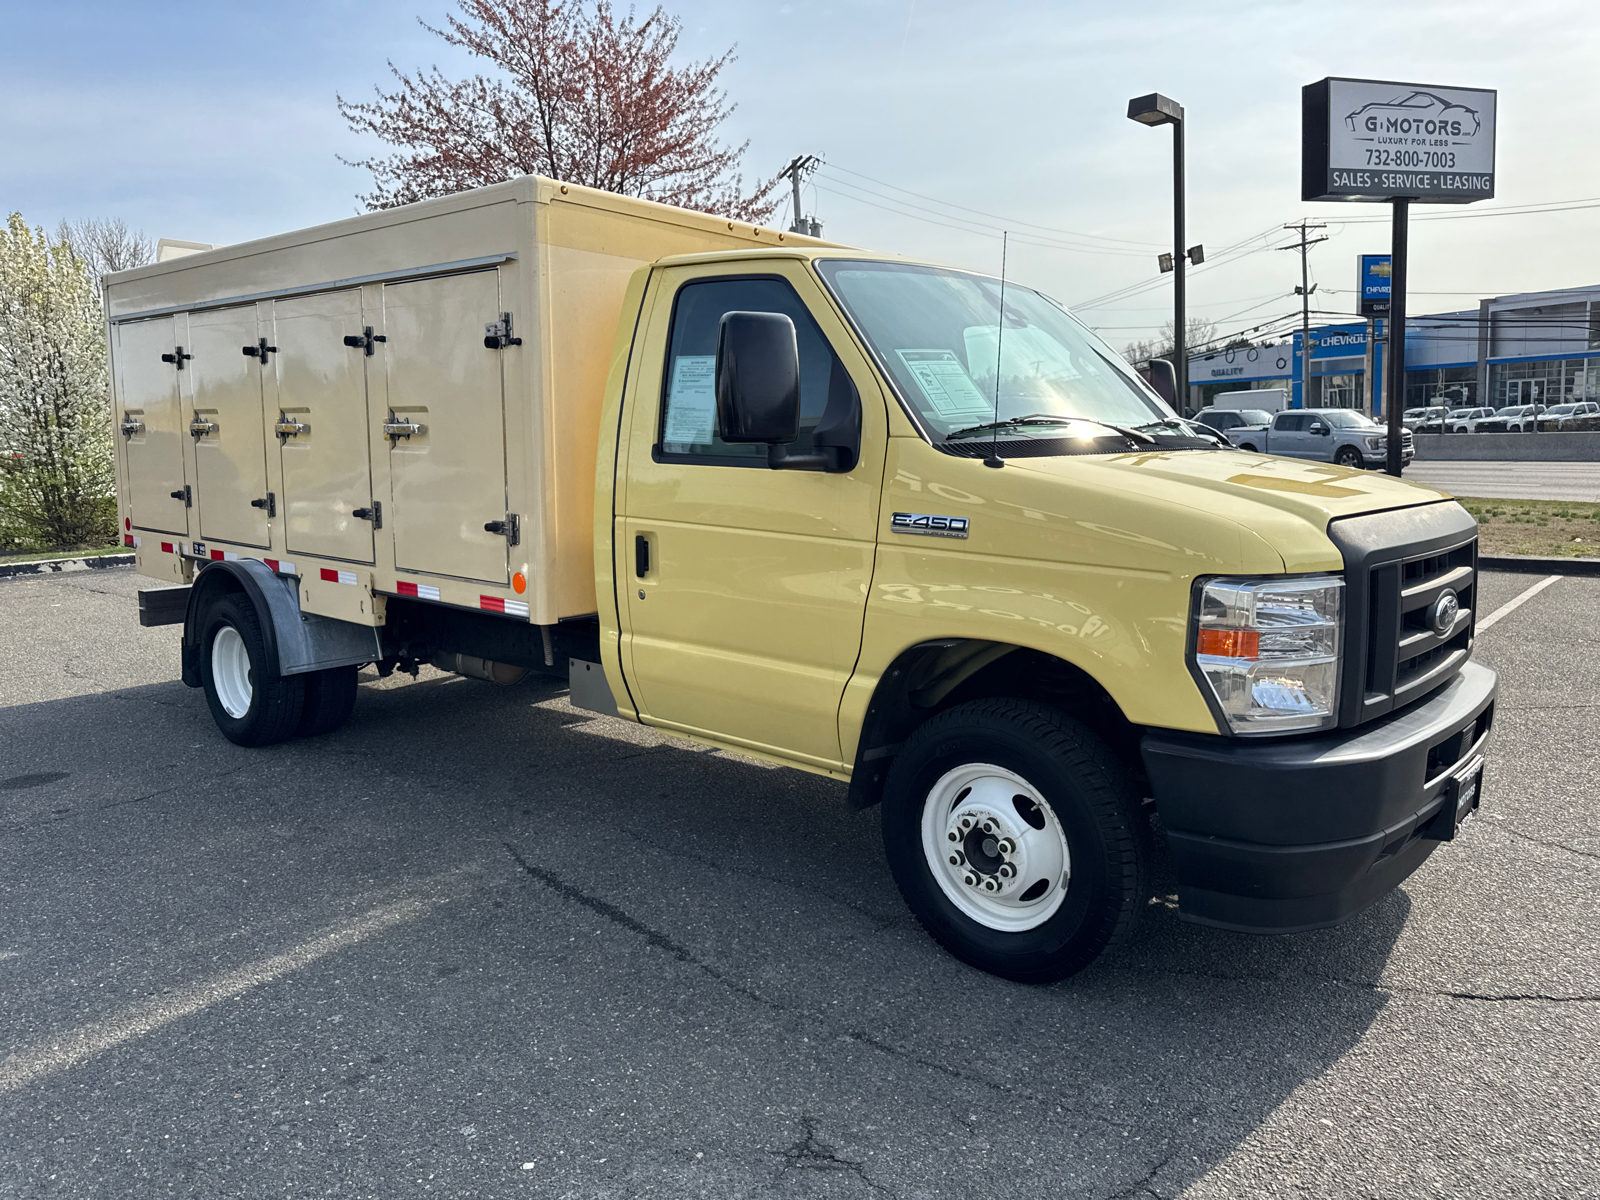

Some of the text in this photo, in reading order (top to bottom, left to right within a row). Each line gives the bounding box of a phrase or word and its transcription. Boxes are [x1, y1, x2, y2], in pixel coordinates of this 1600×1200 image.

[1386, 118, 1462, 136] MOTORS
[1378, 137, 1449, 147] LUXURY FOR LESS
[1365, 149, 1456, 168] 732-800-7003
[1333, 171, 1490, 190] SALES SERVICE LEASING
[1366, 286, 1391, 294] CHEVRO
[1211, 367, 1244, 377] QUALITY
